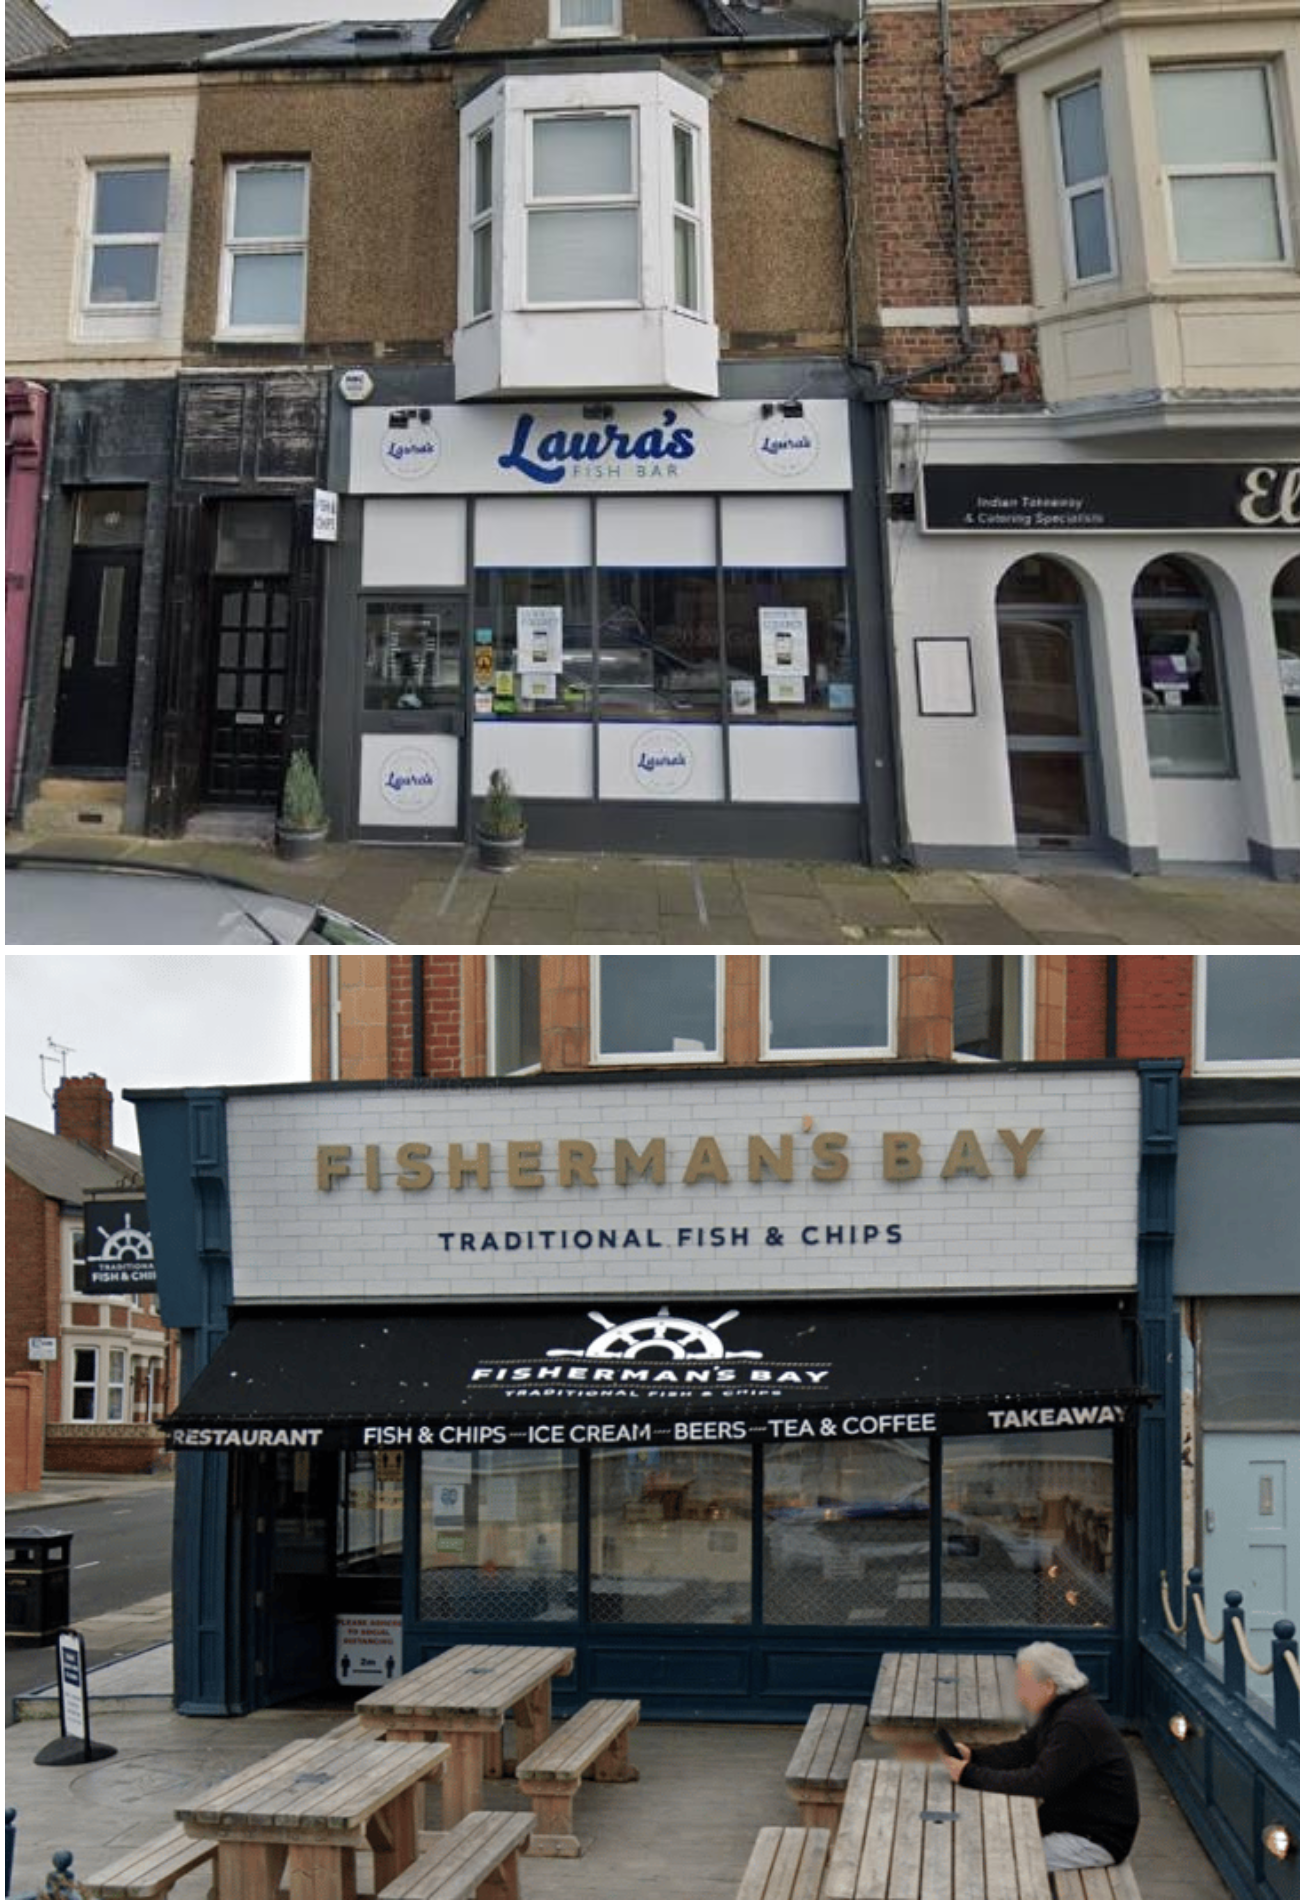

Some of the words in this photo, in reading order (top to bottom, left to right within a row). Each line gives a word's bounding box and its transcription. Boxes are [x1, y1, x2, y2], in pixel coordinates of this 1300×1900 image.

[498, 408, 696, 484] Laura's
[573, 465, 620, 478] FISH
[637, 465, 678, 478] BAR
[977, 497, 1017, 508] Indian
[964, 513, 974, 524] &
[978, 513, 1032, 525] Catering
[316, 1114, 850, 1192] FISHERMAN'S
[882, 1128, 1046, 1180] BAY
[438, 1228, 662, 1251] TRADITIONAL
[678, 1226, 748, 1247] FISH
[765, 1227, 784, 1246] &
[801, 1224, 902, 1246] CHIPS
[92, 1272, 119, 1282] FISH
[121, 1271, 129, 1281] &
[470, 1366, 737, 1382] FISHERMAN'S
[750, 1369, 830, 1383] BAY
[505, 1389, 639, 1397] TRADITIONAL
[723, 1389, 782, 1397] CHIPS
[988, 1405, 1129, 1429] TAKEAWAY
[173, 1428, 323, 1446] RESTAURANT
[363, 1426, 412, 1445] FISH
[417, 1426, 434, 1444] &
[439, 1426, 506, 1444] CHIPS
[528, 1425, 565, 1444] ICE
[569, 1423, 651, 1443] CREAM
[674, 1421, 747, 1441] BEERS
[767, 1418, 814, 1438] TEA
[819, 1417, 837, 1436] &
[842, 1413, 937, 1435] COFFEE
